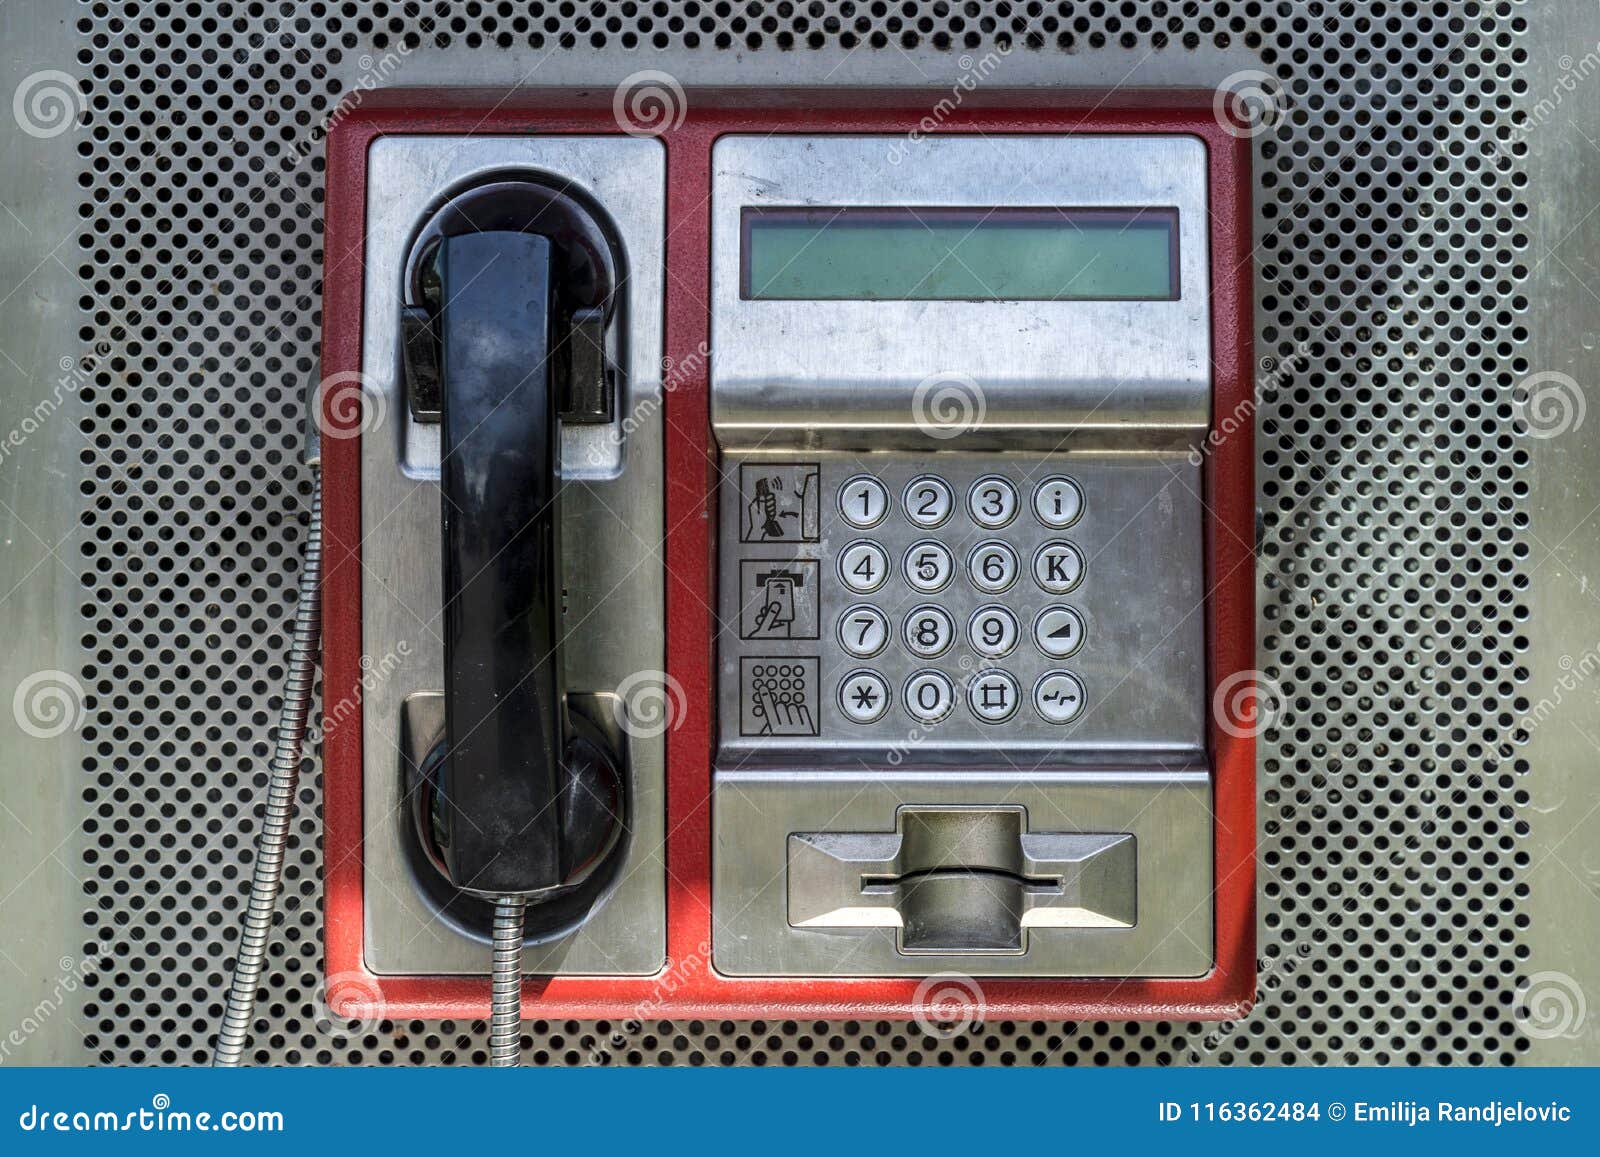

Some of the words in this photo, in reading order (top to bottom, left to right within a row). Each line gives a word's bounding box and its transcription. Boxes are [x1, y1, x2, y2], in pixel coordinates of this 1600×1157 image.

[858, 489, 870, 517] 1
[917, 489, 938, 516] 2
[981, 489, 1003, 516] 3
[1053, 490, 1063, 515] i
[853, 554, 875, 581] 4
[917, 553, 940, 581] 5
[982, 554, 1004, 582] 6
[1046, 554, 1071, 582] K
[854, 618, 875, 646] 7
[917, 618, 940, 646] 8
[982, 617, 1004, 646] 9
